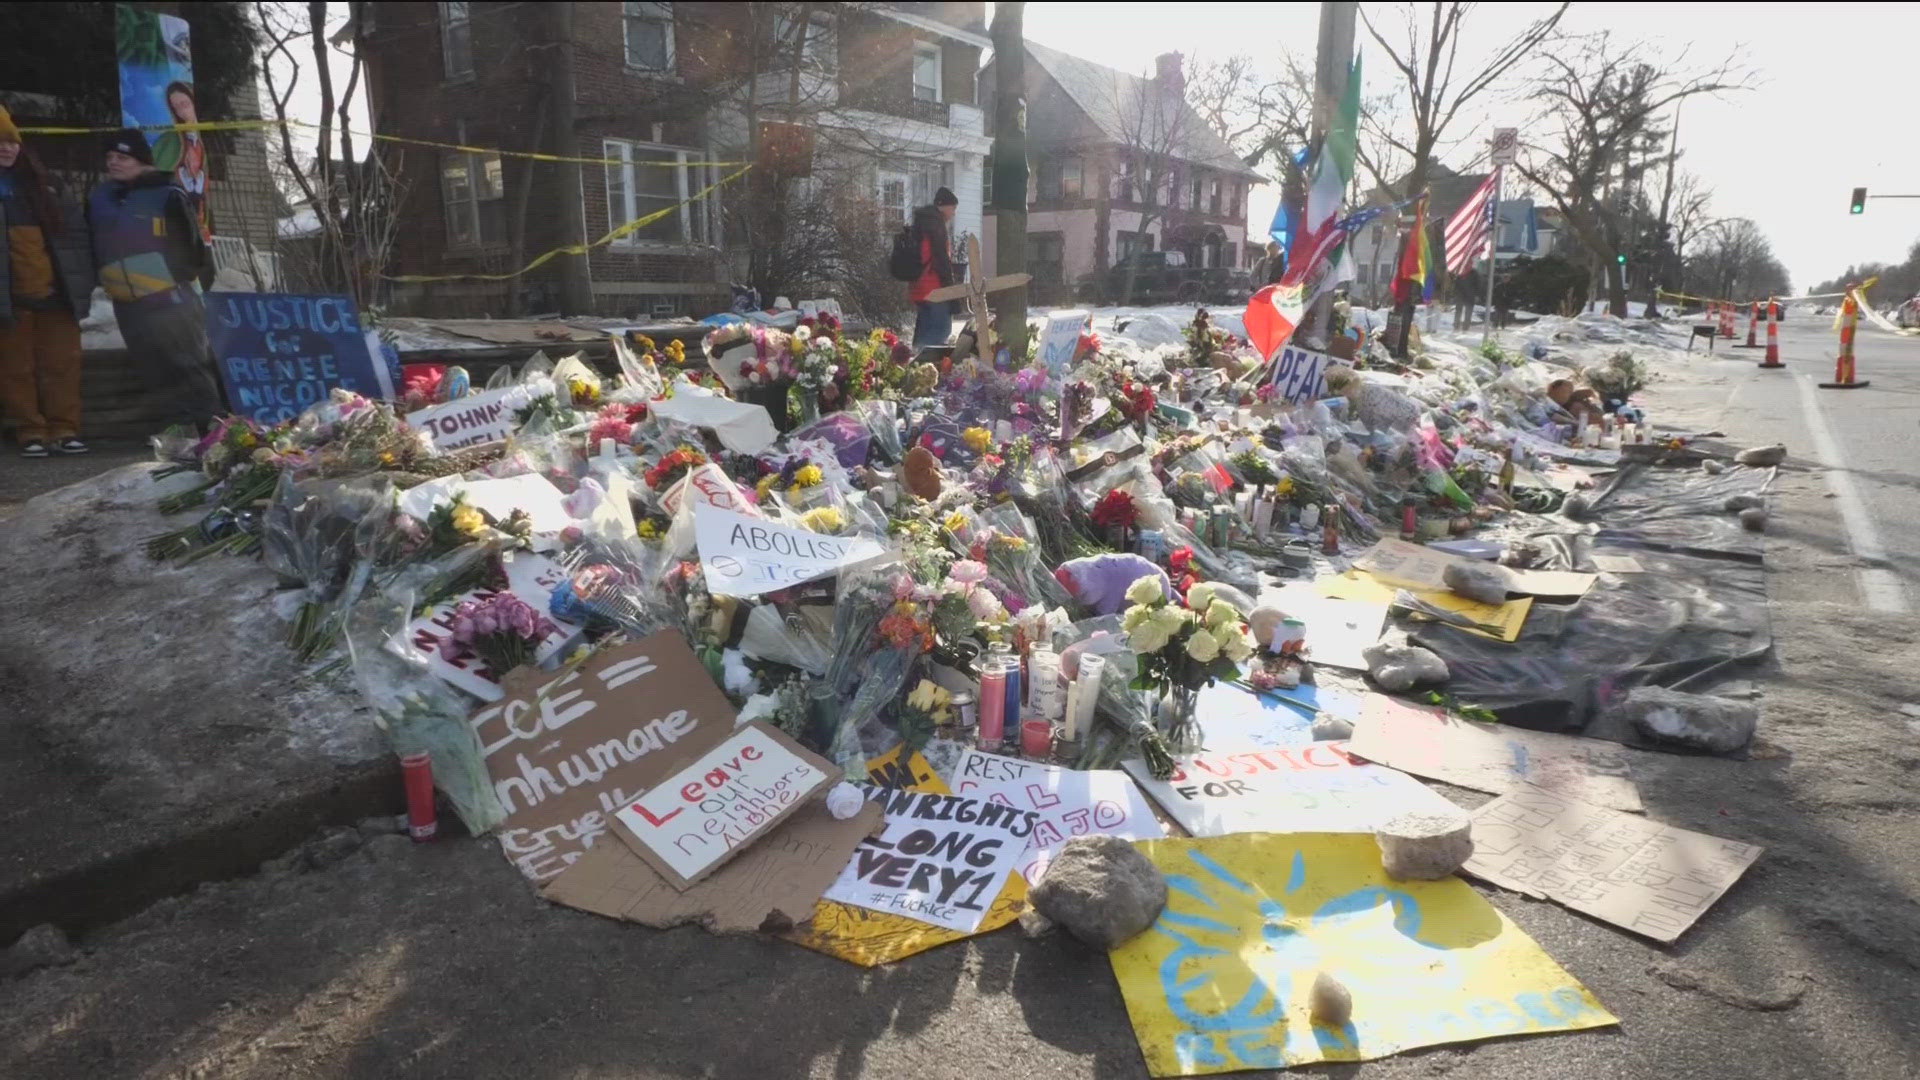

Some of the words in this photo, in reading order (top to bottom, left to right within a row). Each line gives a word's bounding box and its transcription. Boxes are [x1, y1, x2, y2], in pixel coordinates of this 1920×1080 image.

[218, 298, 357, 333] JUSTICE
[226, 354, 339, 382] RENEE
[1275, 349, 1350, 406] PEAC
[238, 378, 355, 407] NICOL
[422, 400, 504, 440] JOHNN
[494, 709, 698, 814] nhumane
[964, 754, 1030, 781] REST
[631, 745, 764, 828] Leave
[699, 774, 749, 814] our
[1176, 778, 1257, 801] FOR
[673, 765, 810, 856] neighbors
[912, 793, 1040, 838] RIGHTS
[855, 847, 997, 912] VERY1
[1500, 858, 1540, 885] RIP
[1531, 869, 1567, 894] RIP
[1633, 862, 1680, 890] RIP
[1561, 877, 1610, 904] RIP
[1650, 887, 1714, 916] ALL
[1631, 911, 1681, 933] TO
